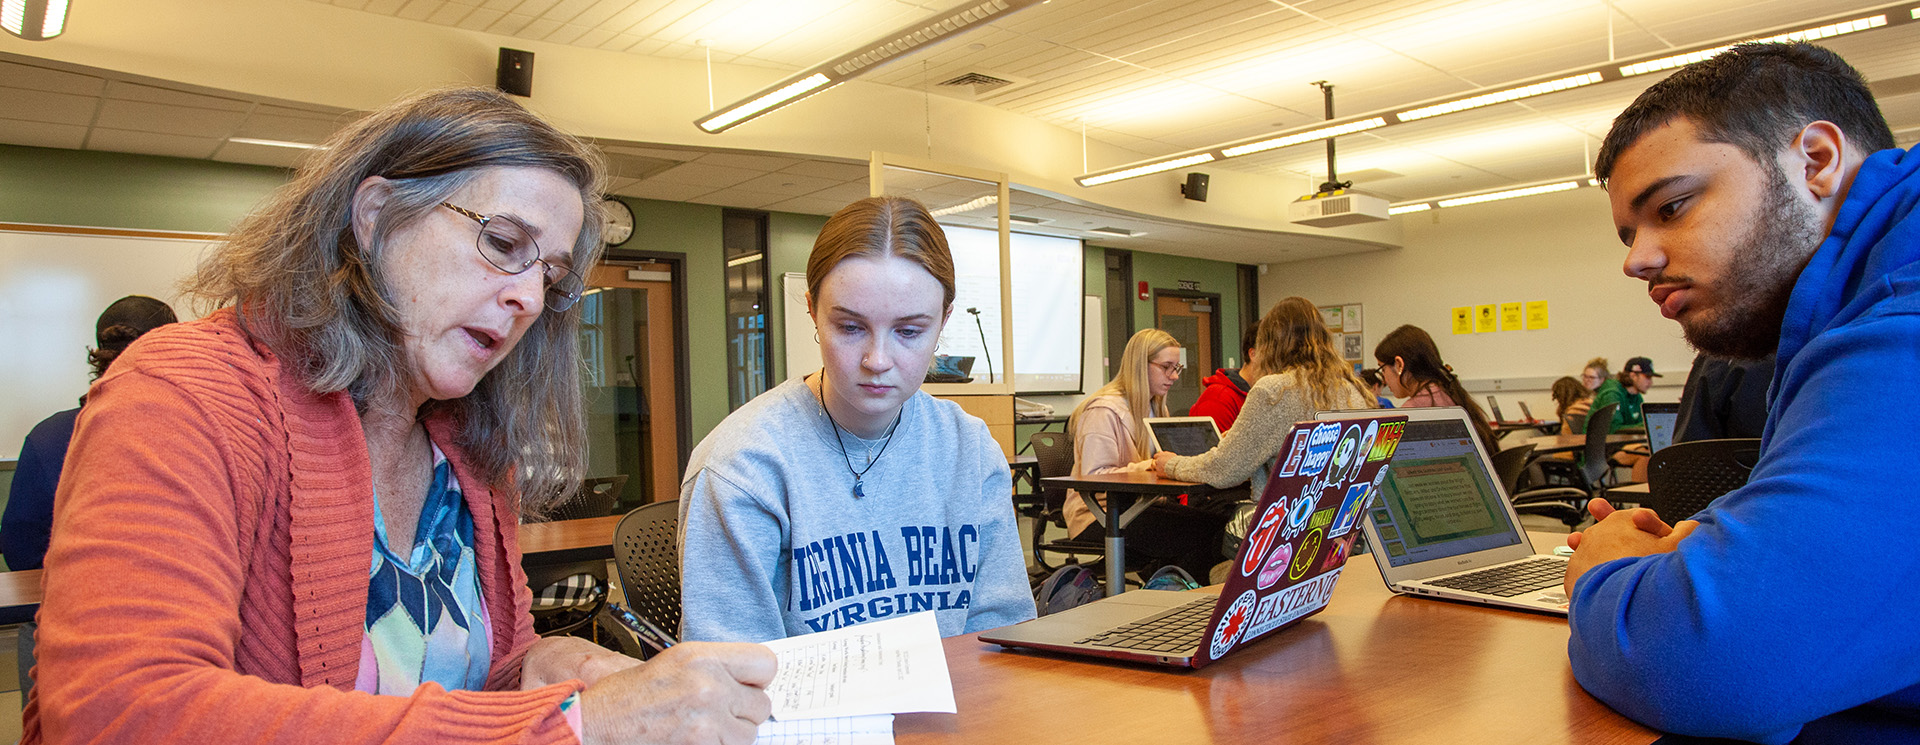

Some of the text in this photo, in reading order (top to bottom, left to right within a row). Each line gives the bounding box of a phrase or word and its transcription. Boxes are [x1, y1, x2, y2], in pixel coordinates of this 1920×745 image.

[1311, 428, 1339, 446] choose
[1304, 450, 1331, 469] happy
[787, 524, 981, 612] IRGINIA BEAC
[805, 590, 971, 633] VIRGINIA
[1250, 574, 1331, 629] EASTERN
